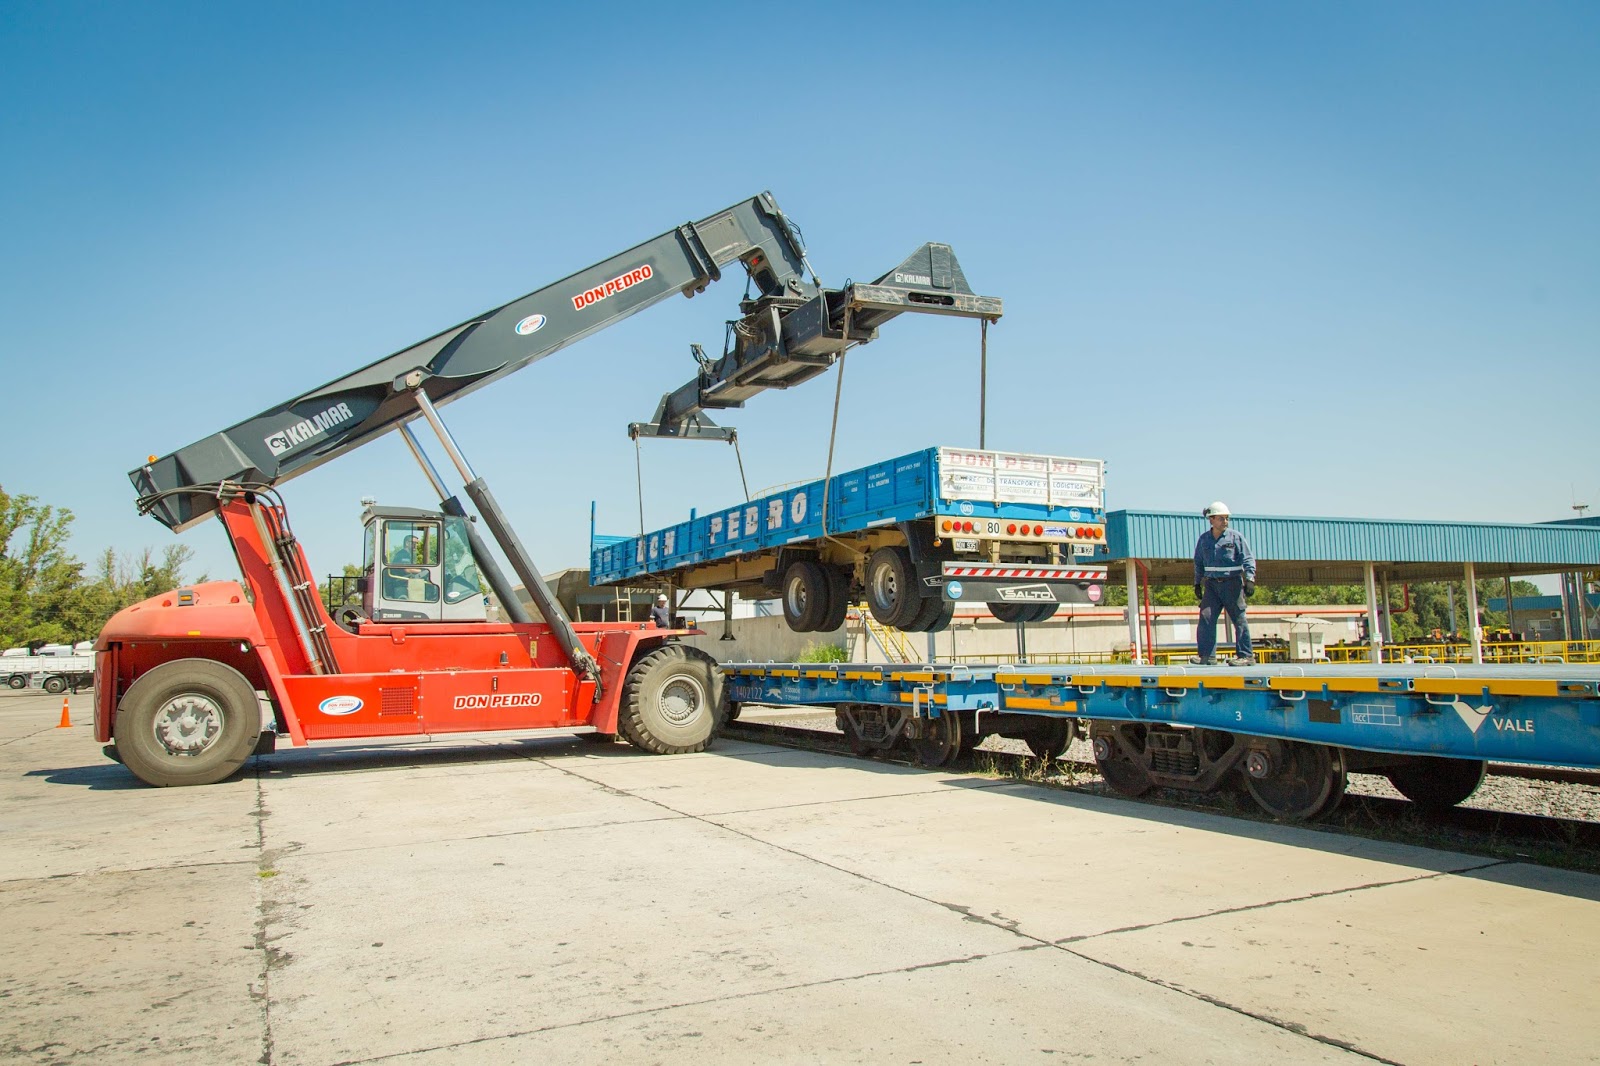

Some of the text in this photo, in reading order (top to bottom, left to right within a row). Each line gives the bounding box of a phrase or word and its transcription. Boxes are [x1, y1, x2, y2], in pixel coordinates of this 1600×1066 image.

[904, 274, 931, 286] KALMAR
[572, 264, 653, 311] DON PEDRO
[286, 402, 353, 445] KALMAR
[949, 452, 1077, 473] DON PEDRO
[1000, 478, 1039, 488] TRANSPORTE
[1052, 481, 1084, 490] LOGISTICA
[710, 492, 807, 544] PEDRO
[987, 522, 1000, 534] 80
[1004, 589, 1051, 599] SALTO
[454, 693, 542, 709] DON PEDRO
[1235, 711, 1242, 721] 3
[1354, 714, 1367, 723] ACC
[1492, 718, 1535, 732] VALE
